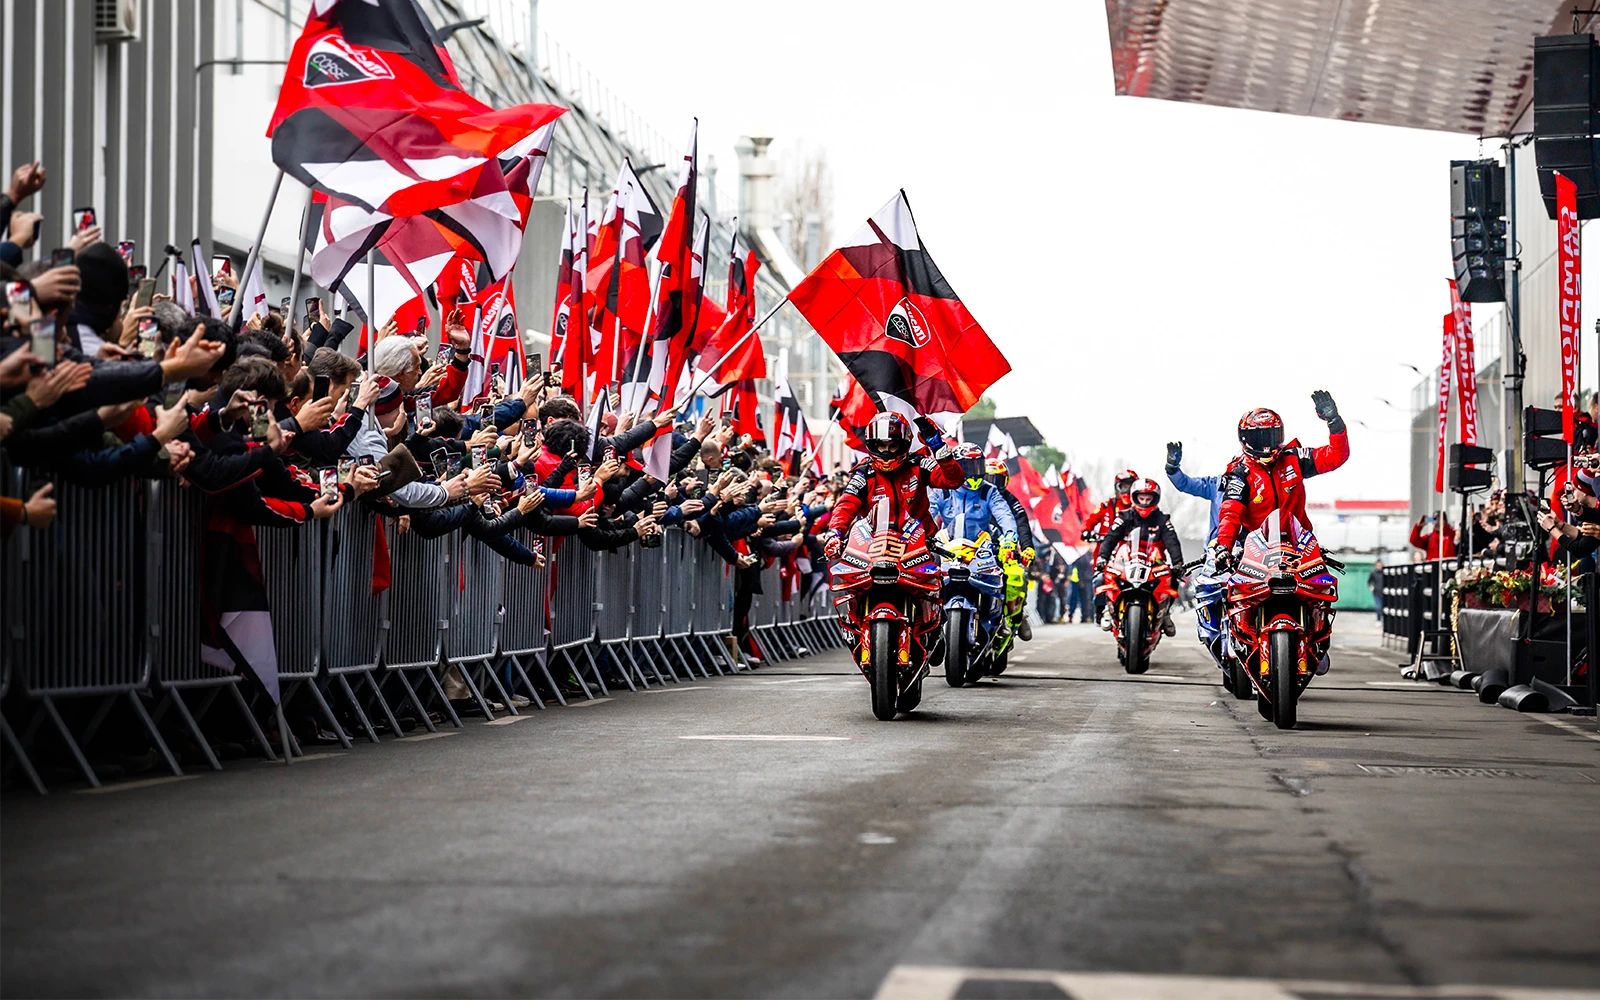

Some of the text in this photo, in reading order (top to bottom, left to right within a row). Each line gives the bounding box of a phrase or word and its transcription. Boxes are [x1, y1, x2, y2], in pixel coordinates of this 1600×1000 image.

[312, 54, 349, 80] CORSE
[867, 540, 906, 558] 93
[842, 553, 869, 569] Lenovo
[901, 553, 930, 569] Lenovo
[1129, 566, 1147, 580] 11
[1240, 565, 1266, 579] Lenovo
[1299, 564, 1325, 578] Lenovo
